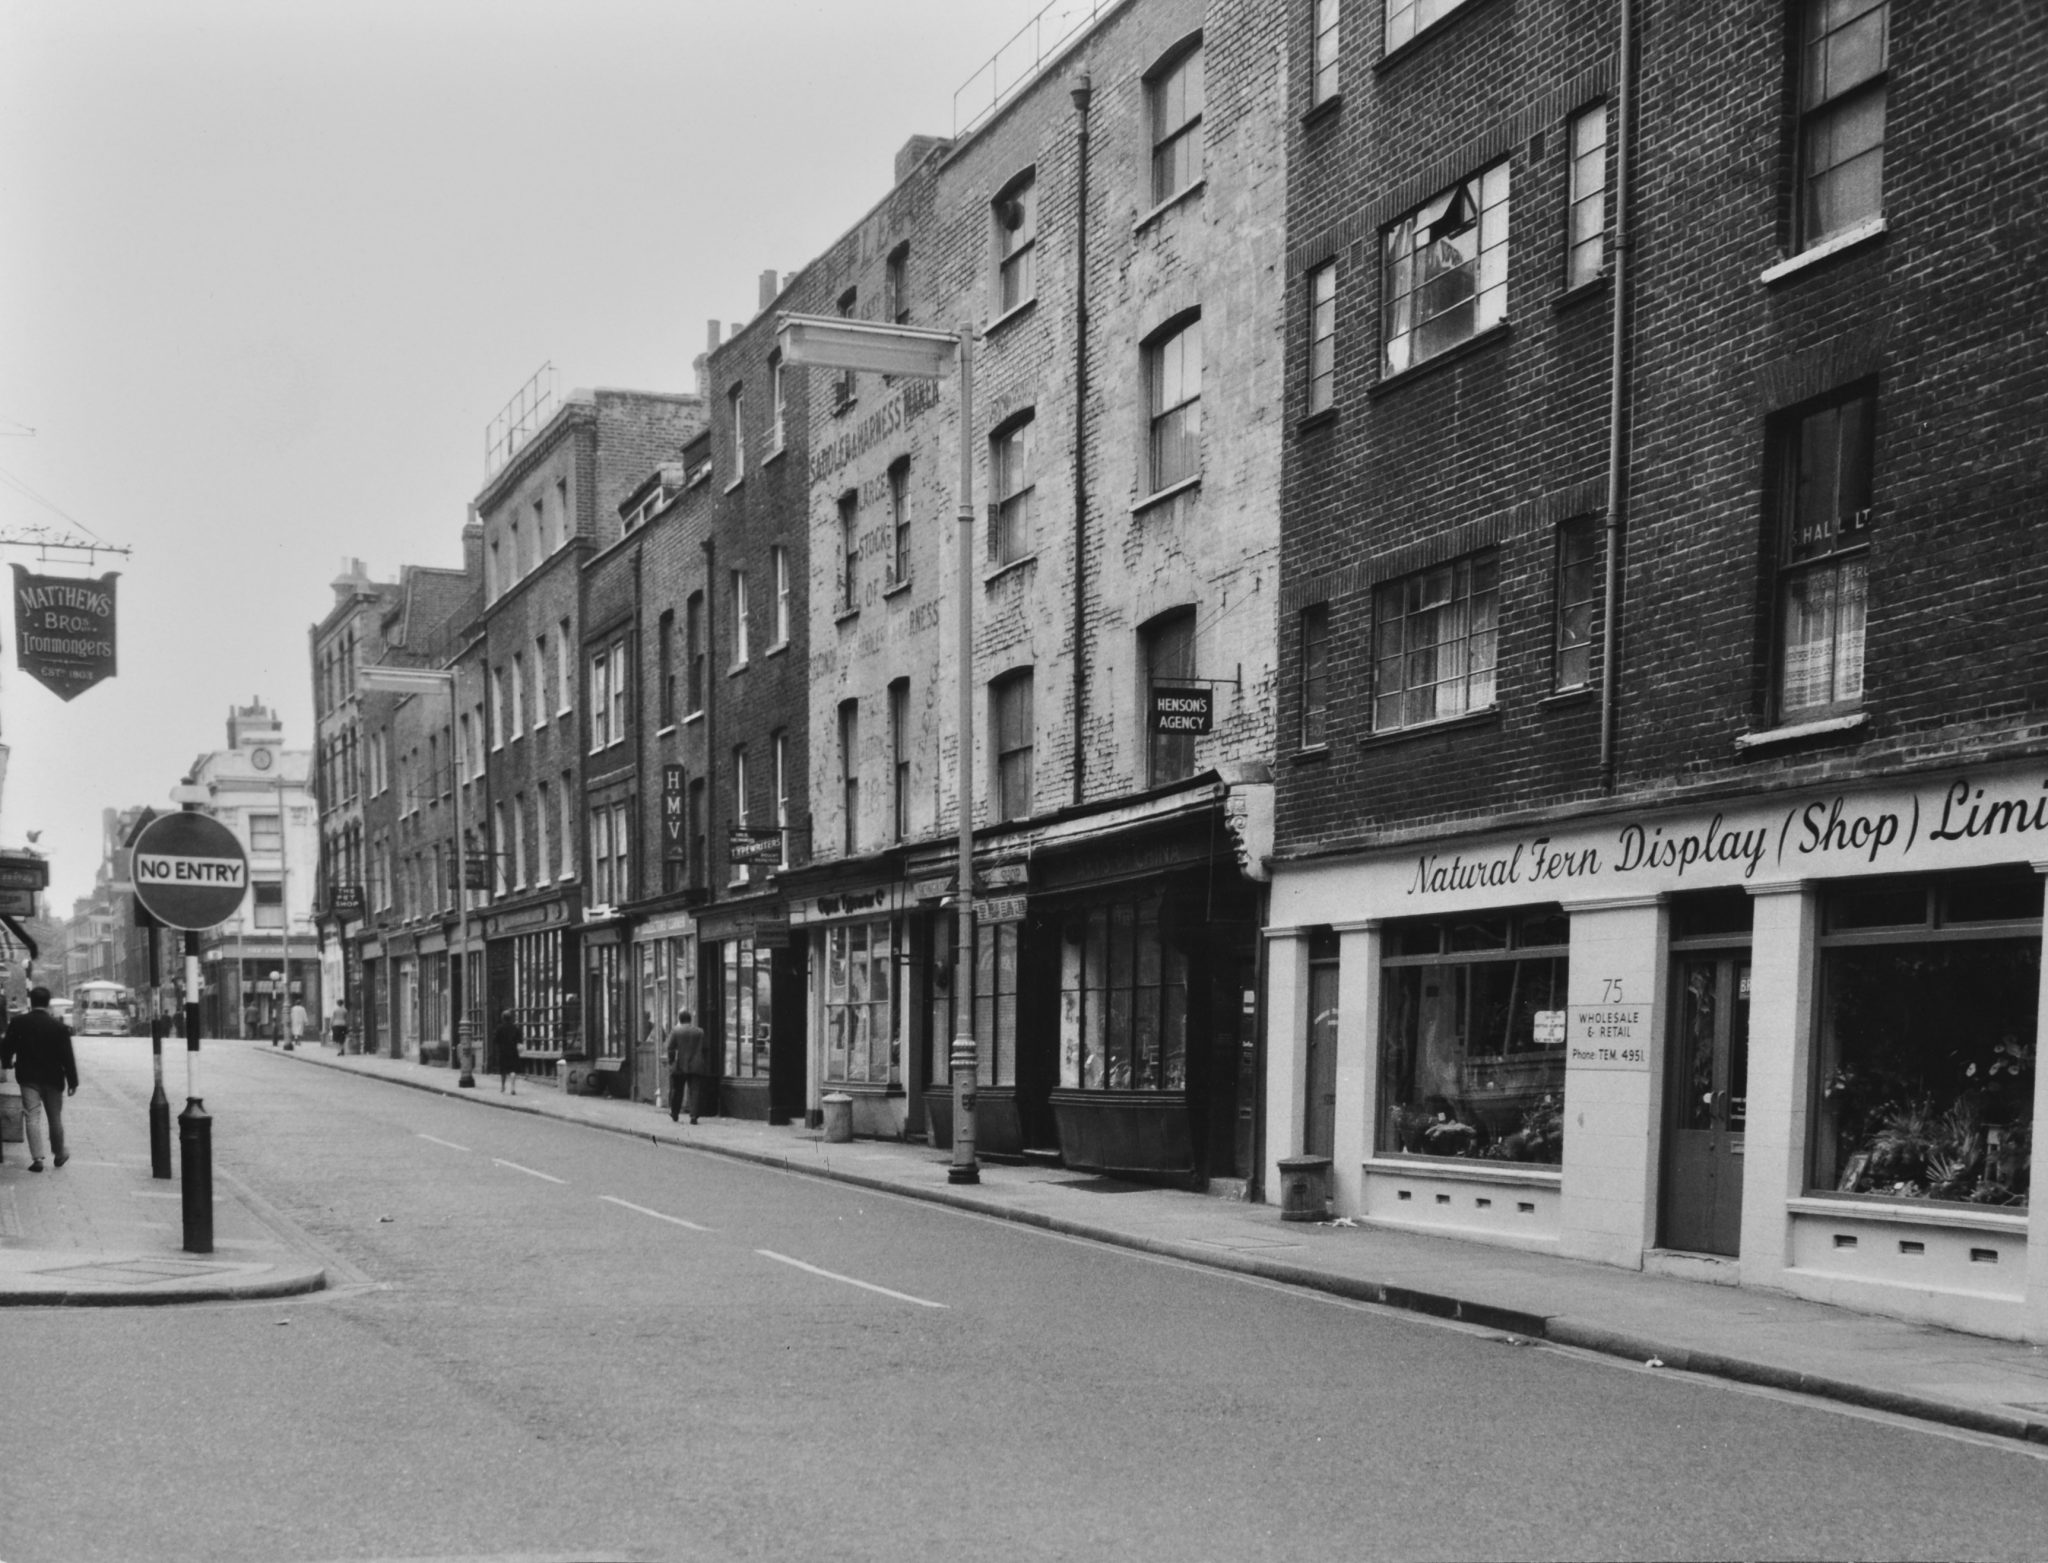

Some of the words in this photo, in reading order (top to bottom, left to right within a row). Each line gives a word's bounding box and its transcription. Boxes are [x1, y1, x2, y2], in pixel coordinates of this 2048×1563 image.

[19, 585, 112, 618] MATTHEWS
[22, 631, 112, 657] Ironmongers
[1157, 697, 1208, 713] HENSON'S
[1159, 715, 1206, 730] AGENCY
[731, 838, 781, 858] TYPEWRITERS
[1407, 843, 1524, 896] Natural
[1528, 836, 1603, 883] Fern
[1614, 813, 1767, 878] Display
[1777, 793, 1920, 867] (Shop)
[140, 860, 170, 879] NO
[174, 861, 242, 882] ENTRY
[335, 900, 359, 908] SHOP
[1602, 978, 1623, 1004] 75
[1579, 1011, 1639, 1024] WHOLESALE
[1587, 1026, 1595, 1038] &
[1600, 1026, 1631, 1038] RETAIL
